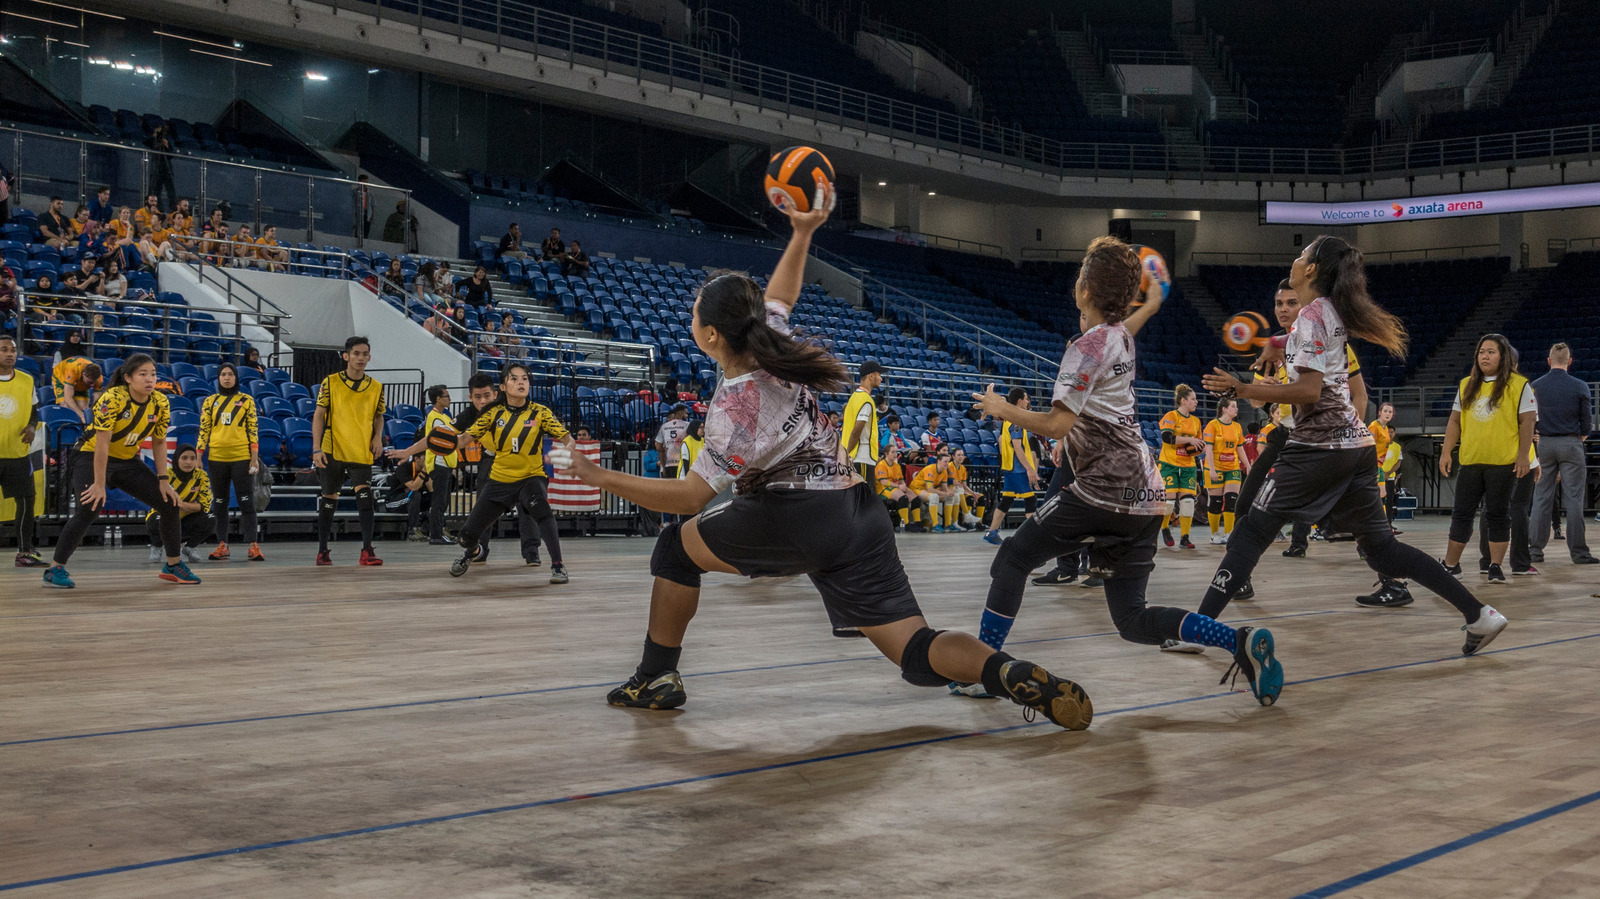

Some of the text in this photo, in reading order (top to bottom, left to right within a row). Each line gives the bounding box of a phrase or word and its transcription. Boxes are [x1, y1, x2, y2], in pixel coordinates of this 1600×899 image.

[1321, 200, 1484, 220] Welcome to axiata arena
[124, 433, 140, 446] 10
[670, 430, 678, 439] 5
[512, 437, 519, 453] 9
[1225, 441, 1235, 449] 15
